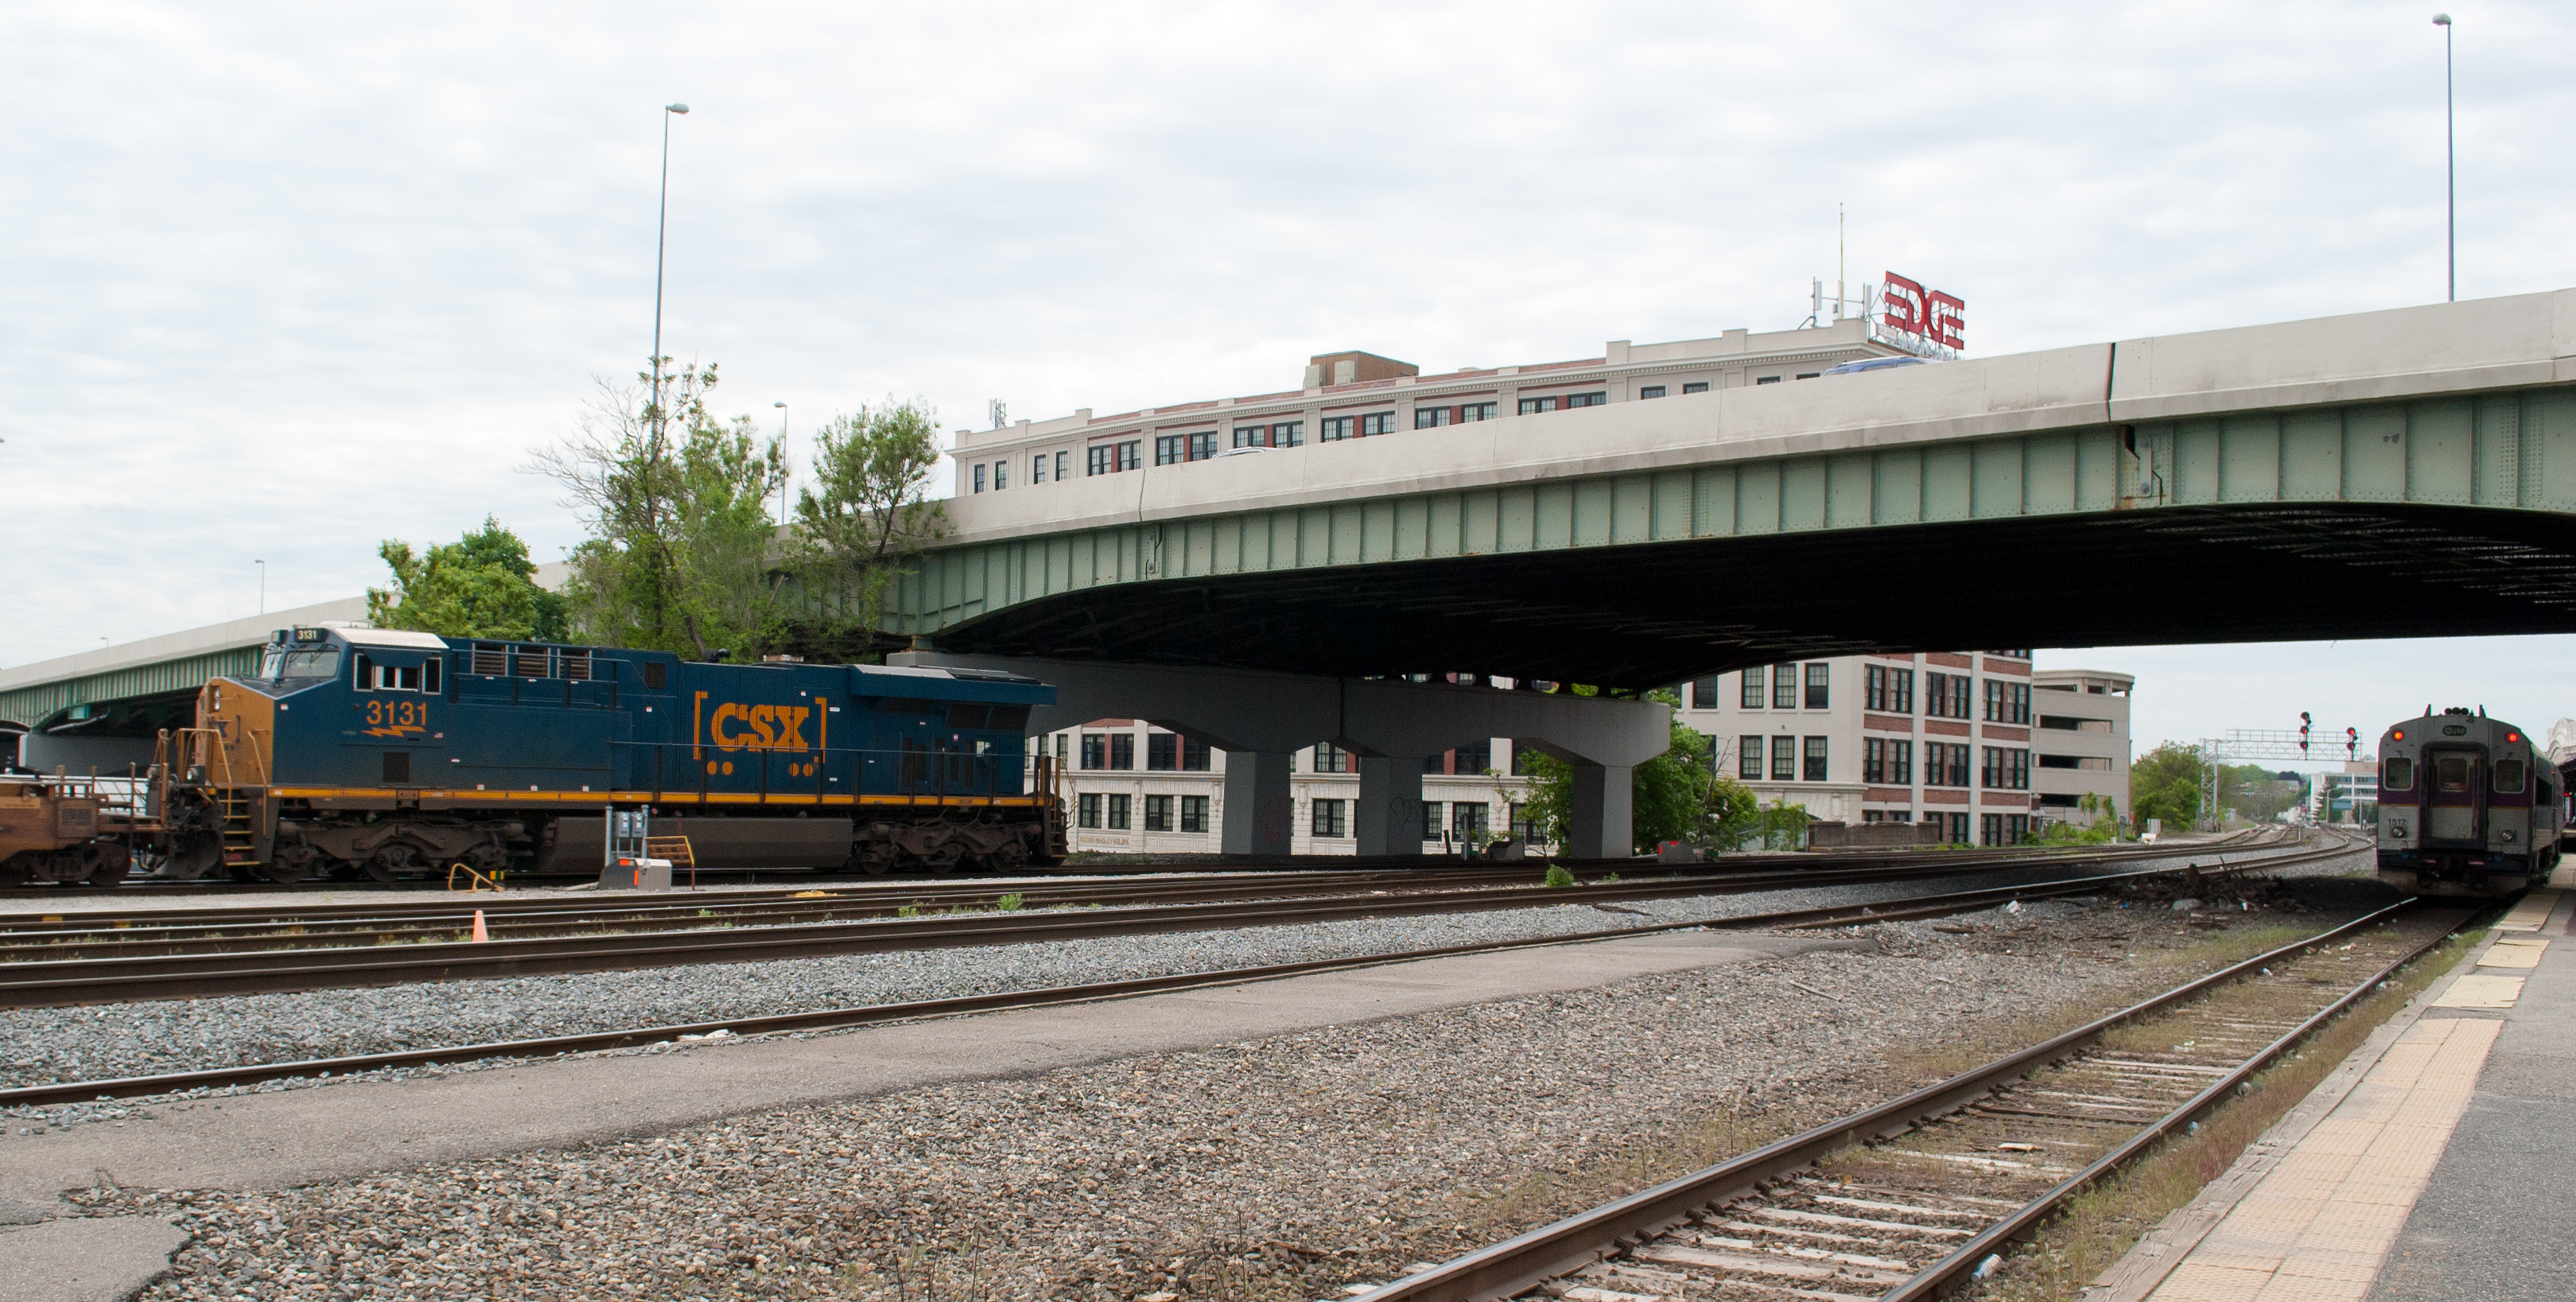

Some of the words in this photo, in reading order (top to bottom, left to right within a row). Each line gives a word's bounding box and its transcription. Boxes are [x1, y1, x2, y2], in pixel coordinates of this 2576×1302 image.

[1885, 270, 1964, 350] EDGE
[297, 629, 317, 640] 3131
[366, 700, 427, 725] 3131
[711, 702, 810, 752] CSX
